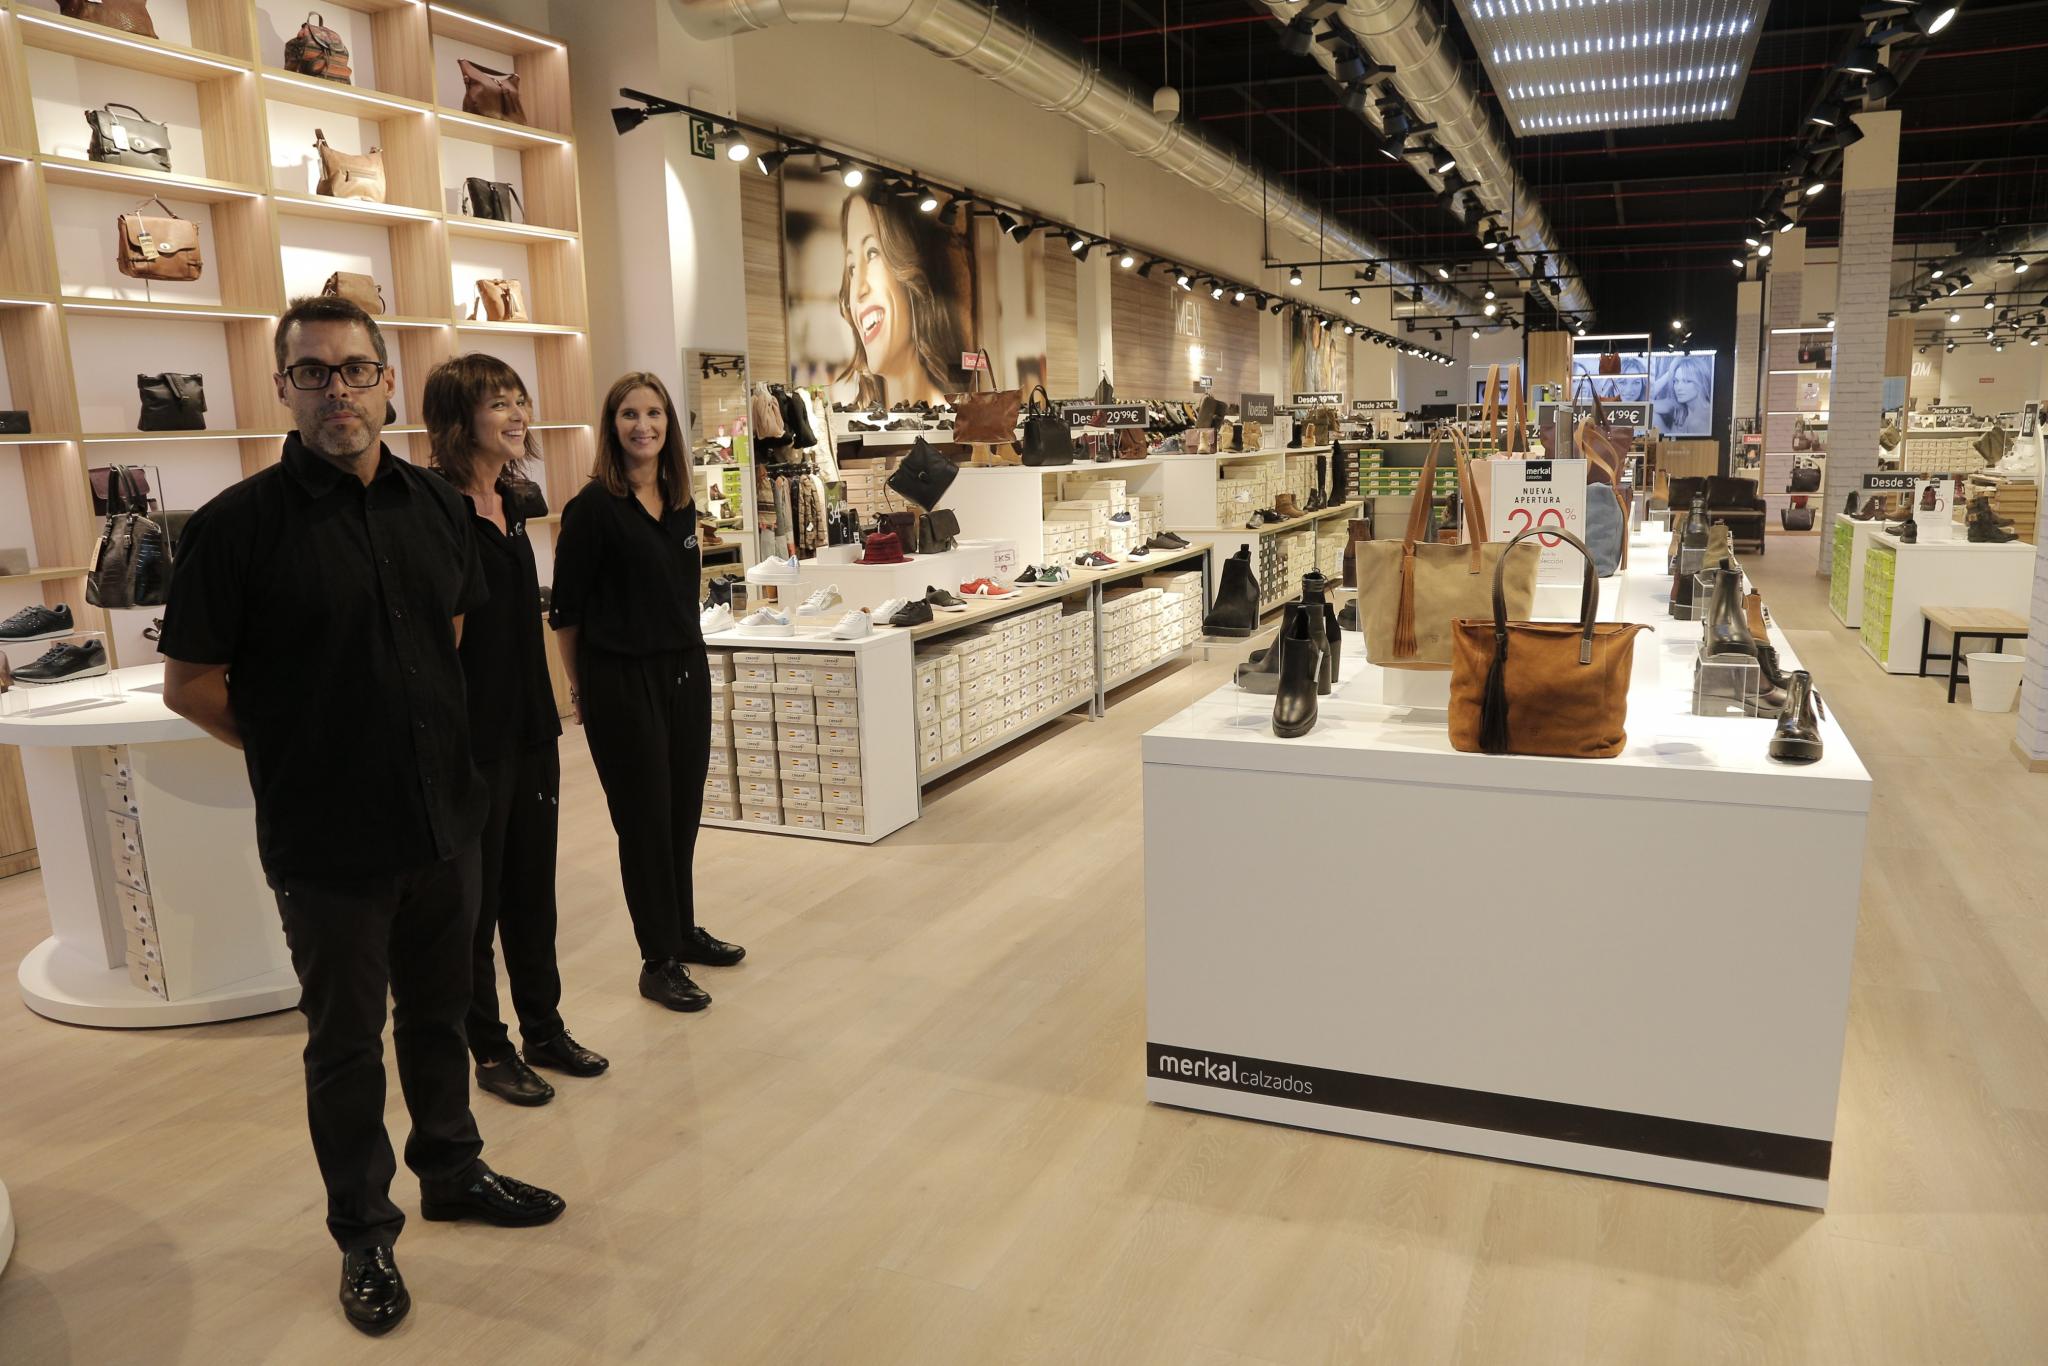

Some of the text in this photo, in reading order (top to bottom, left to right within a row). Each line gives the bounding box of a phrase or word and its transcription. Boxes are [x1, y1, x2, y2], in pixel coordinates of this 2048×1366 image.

[1175, 297, 1201, 338] MEN
[1912, 361, 1932, 377] OM
[1357, 401, 1375, 409] Desde
[1526, 467, 1551, 475] merkal
[1871, 477, 1904, 488] Desde
[1522, 487, 1553, 495] NUEVA
[1514, 496, 1561, 504] APERTURA
[1159, 1055, 1313, 1095] merkal calzados
